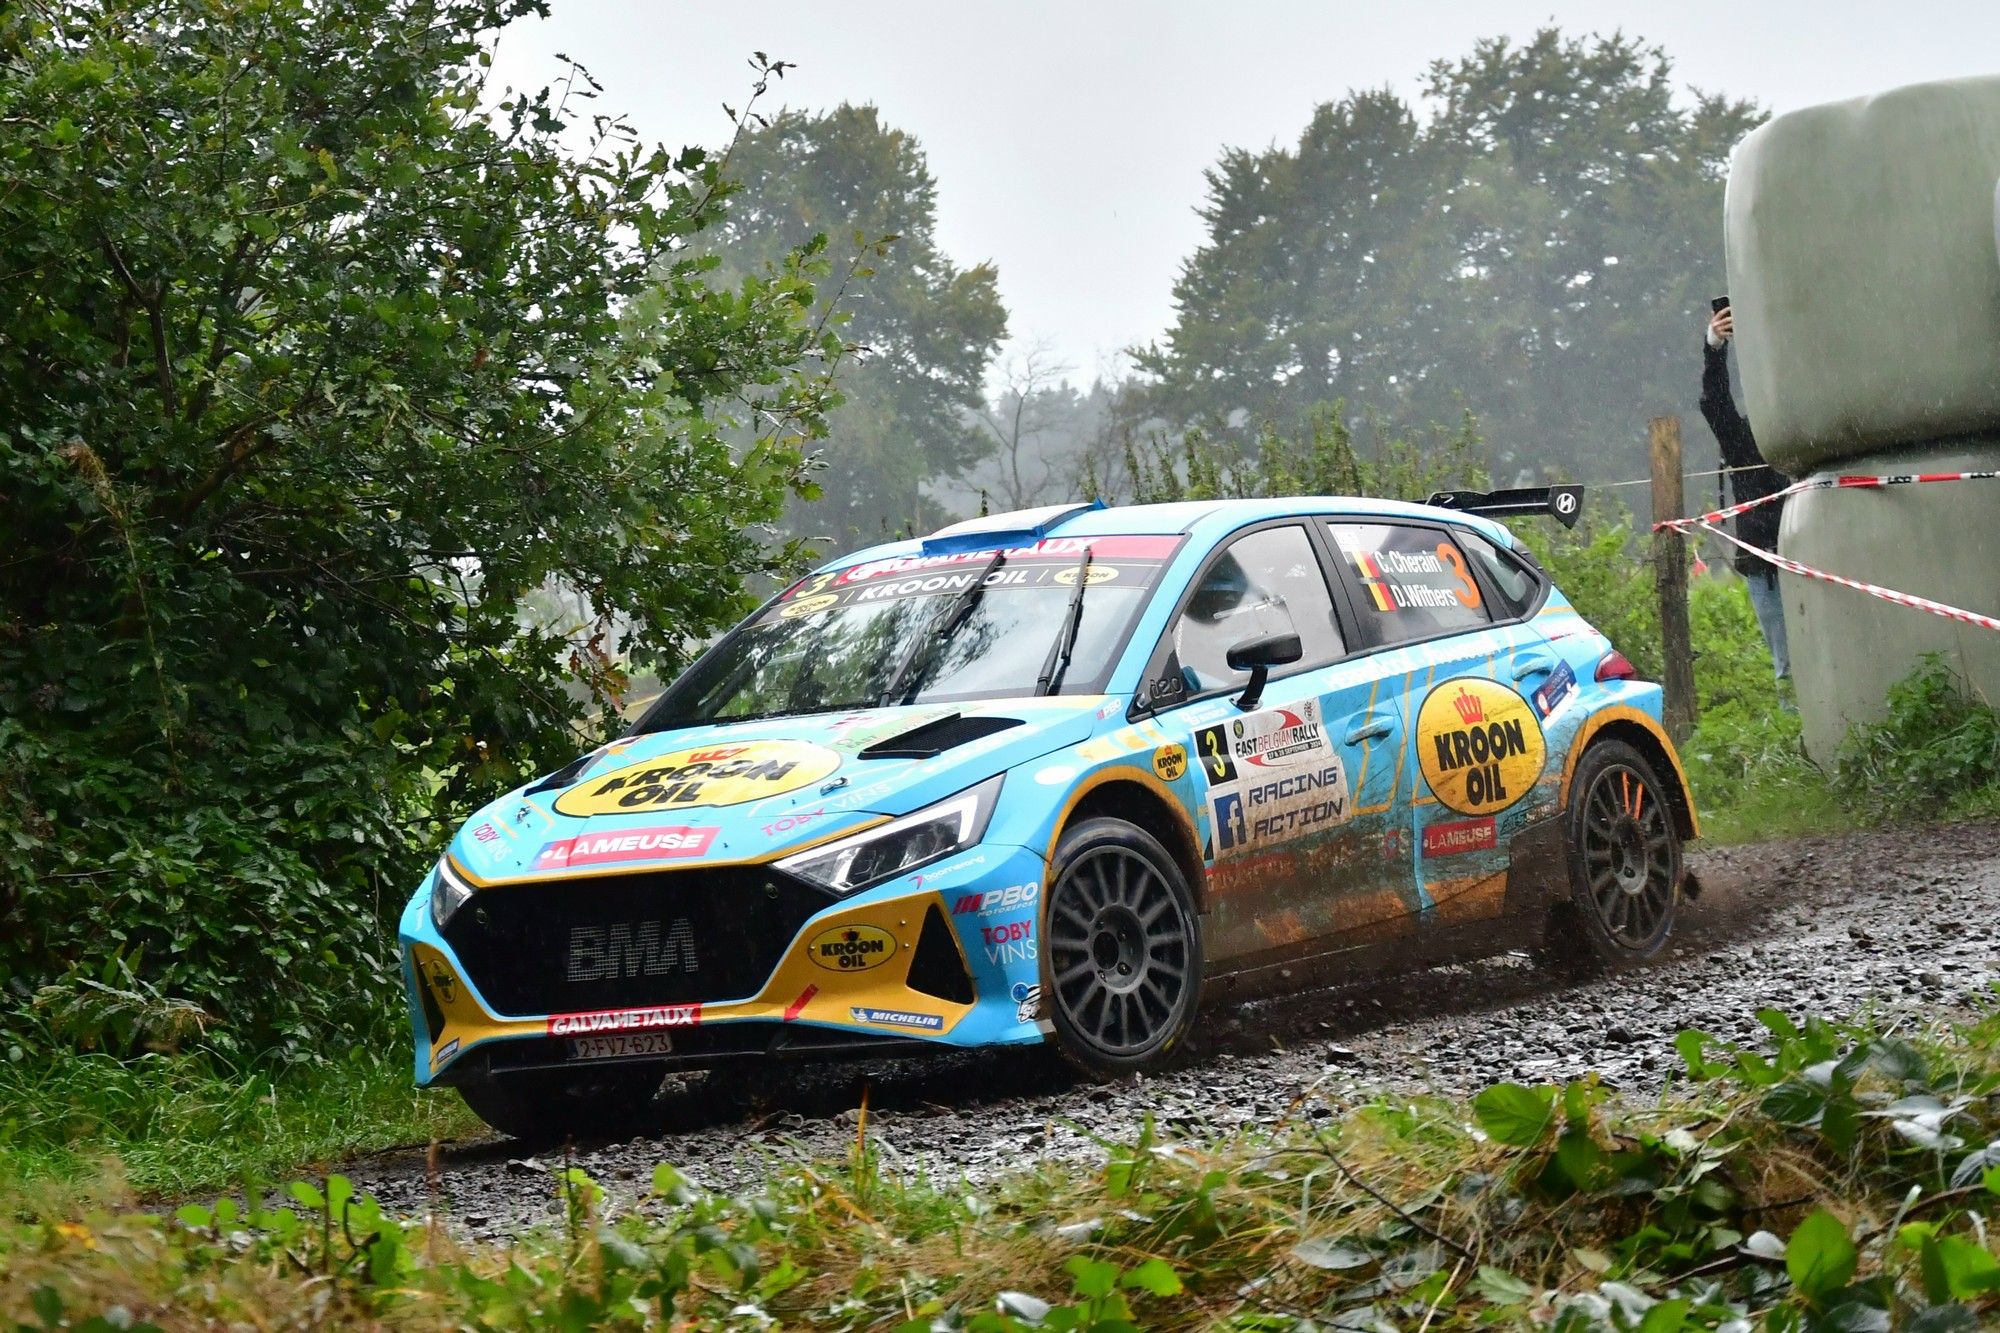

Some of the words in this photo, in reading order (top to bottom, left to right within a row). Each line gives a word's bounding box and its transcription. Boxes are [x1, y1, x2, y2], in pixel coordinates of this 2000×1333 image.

[1389, 550, 1442, 573] Cherain
[795, 573, 837, 598] 3
[1436, 543, 1481, 609] 3
[1206, 730, 1227, 778] 3
[1235, 737, 1258, 758] EAST
[1258, 728, 1294, 752] BELGIAN
[1292, 722, 1320, 744] RALLY
[1433, 718, 1527, 771] KROON
[1157, 751, 1182, 769] KROON
[1166, 765, 1179, 778] OIL
[590, 759, 800, 797] KROON
[1249, 766, 1337, 807] RACING
[1466, 763, 1507, 806] OIL
[618, 782, 705, 807] OIL
[761, 808, 825, 836] TOBY
[1252, 797, 1344, 840] ACTION
[981, 882, 1039, 911] PBO
[981, 920, 1032, 945] TOBY
[567, 918, 699, 982] BMA
[821, 940, 884, 956] KROON
[838, 954, 867, 969] OIL
[984, 938, 1038, 966] VINS
[552, 1008, 694, 1035] GALVAMETAUX
[871, 1012, 939, 1026] MICHELIN
